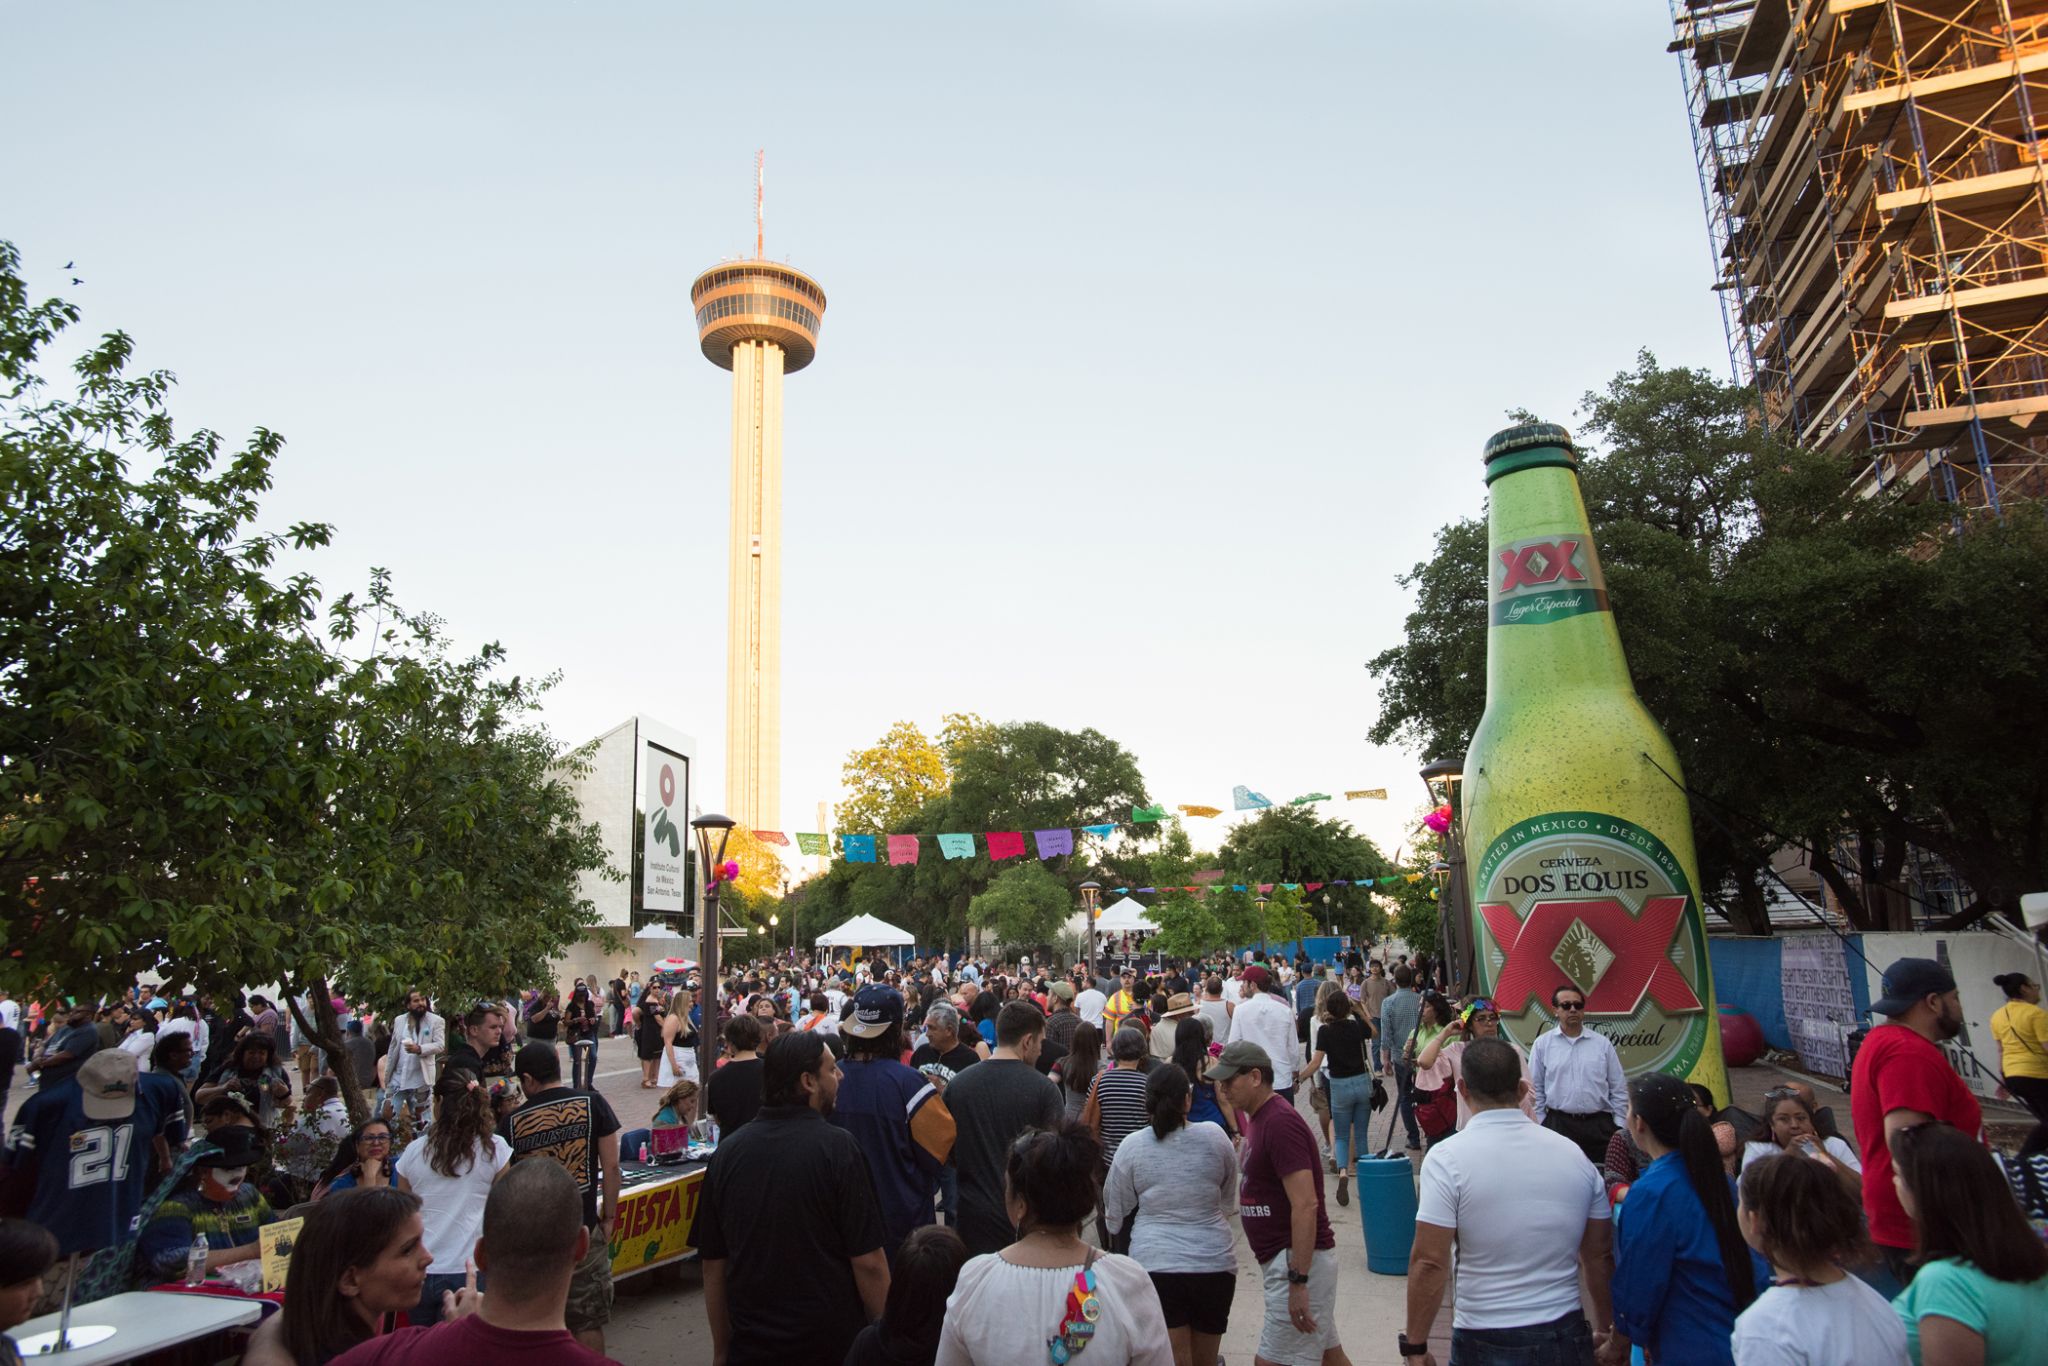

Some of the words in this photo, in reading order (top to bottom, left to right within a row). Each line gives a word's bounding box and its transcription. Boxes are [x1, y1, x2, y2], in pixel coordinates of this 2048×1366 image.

[1498, 541, 1586, 593] XX
[1504, 601, 1535, 621] Lager
[1535, 595, 1582, 615] Especial
[1479, 842, 1509, 889] CRAFTED
[1511, 830, 1526, 843] IN
[1530, 819, 1589, 835] MEXICO
[1610, 825, 1653, 850] DESDE
[1656, 850, 1680, 877] 1897
[1540, 856, 1602, 869] CERVEZA
[1504, 875, 1555, 895] DOS
[1564, 870, 1649, 892] EQUIS
[1479, 895, 1705, 1016] XX
[69, 1123, 134, 1190] 21
[515, 1124, 588, 1152] HOLLISTER
[612, 1184, 681, 1241] FIESTA
